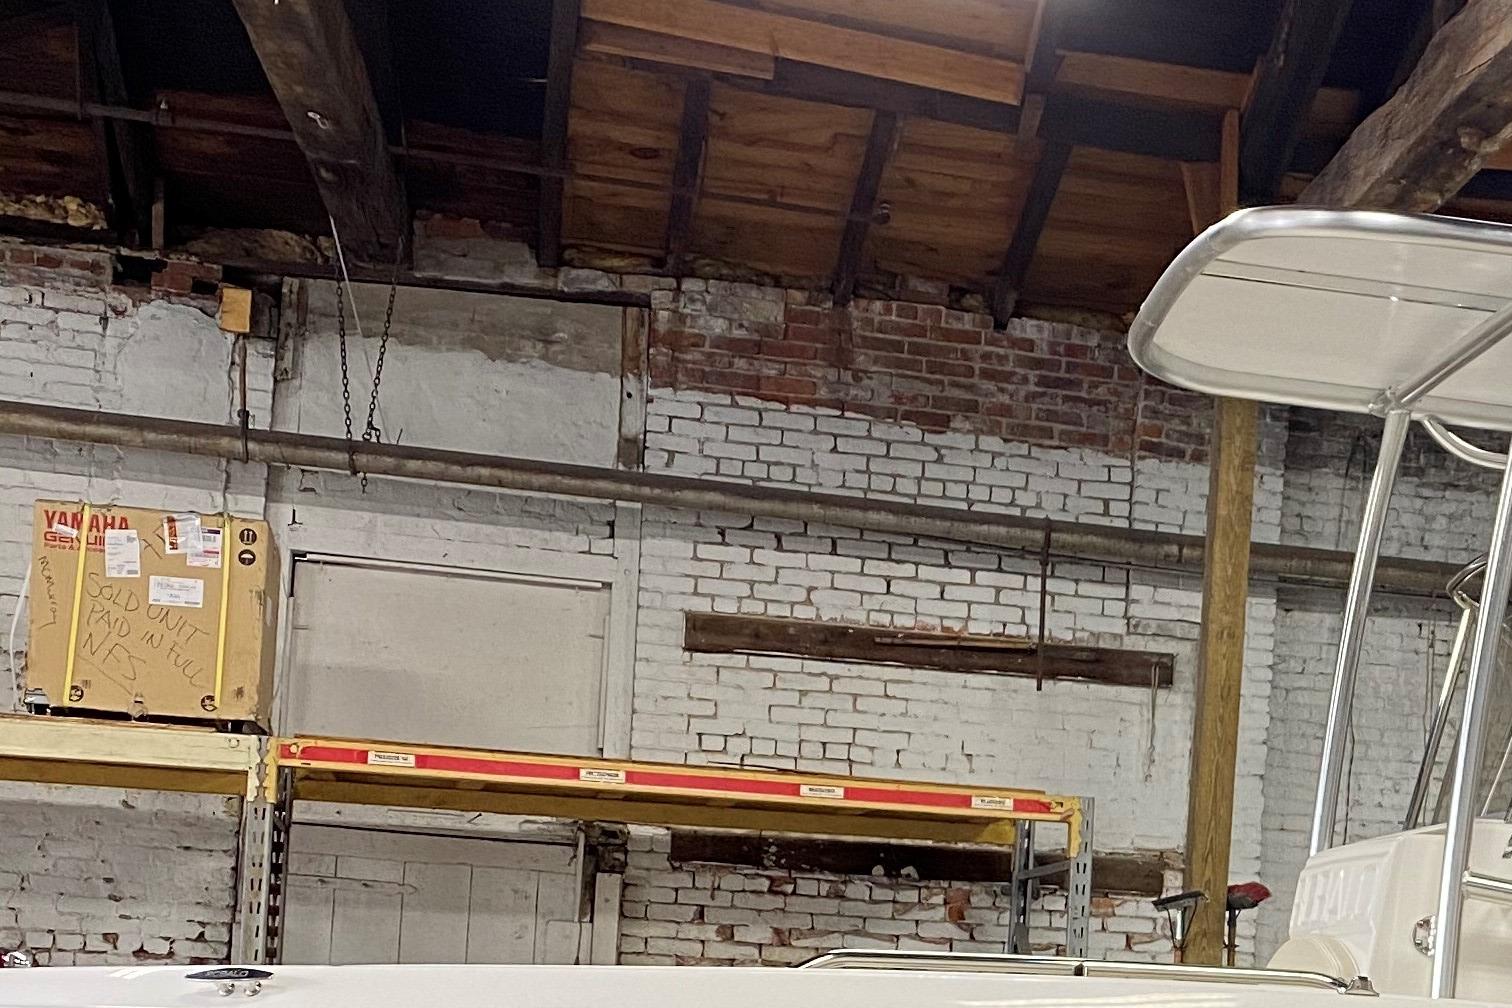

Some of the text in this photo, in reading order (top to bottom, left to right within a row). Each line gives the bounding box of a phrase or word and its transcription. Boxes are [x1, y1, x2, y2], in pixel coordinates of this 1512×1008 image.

[87, 572, 140, 612] SOLD
[147, 604, 210, 644] UNIT
[87, 603, 131, 638] PAID
